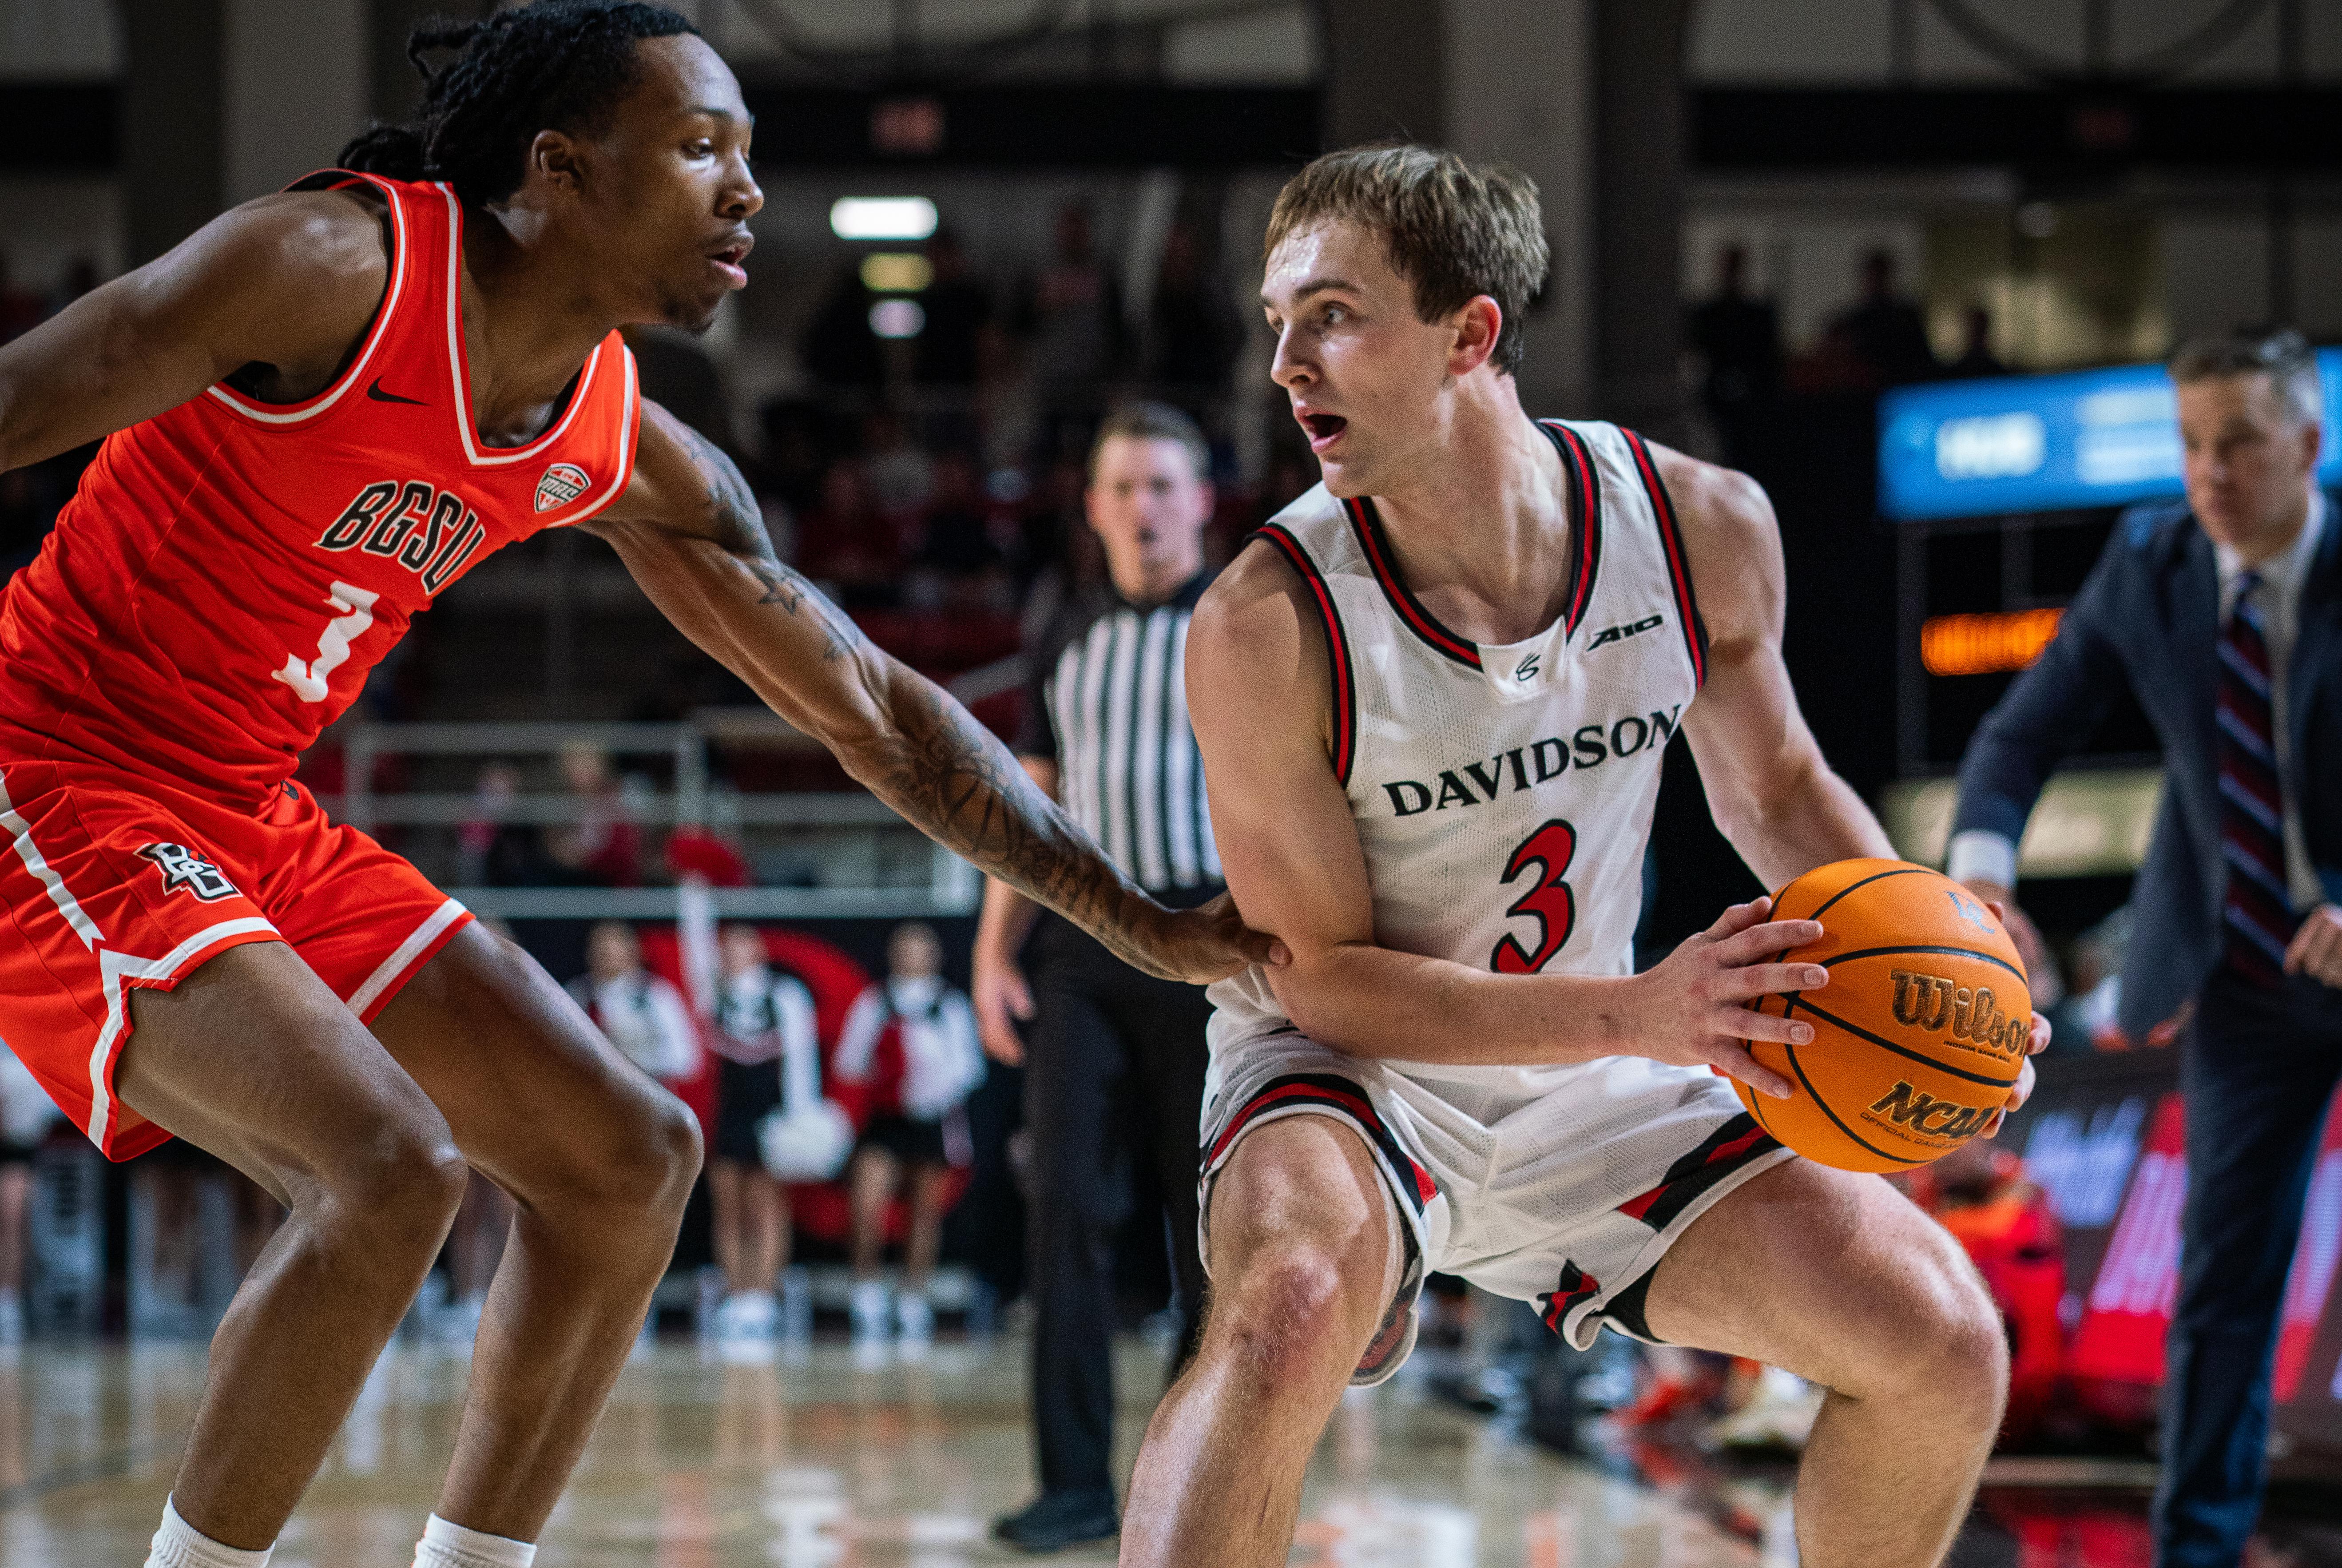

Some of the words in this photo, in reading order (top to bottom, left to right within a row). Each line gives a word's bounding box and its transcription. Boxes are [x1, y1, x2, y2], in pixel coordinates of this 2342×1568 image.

[312, 480, 486, 595] BGSU
[1382, 703, 1682, 817] DAVIDSON
[1490, 818, 1577, 973] 3
[1943, 1040, 1976, 1052] INDOOR
[1860, 1111, 1911, 1141] OFFICIAL
[1868, 1079, 1999, 1139] NCAA
